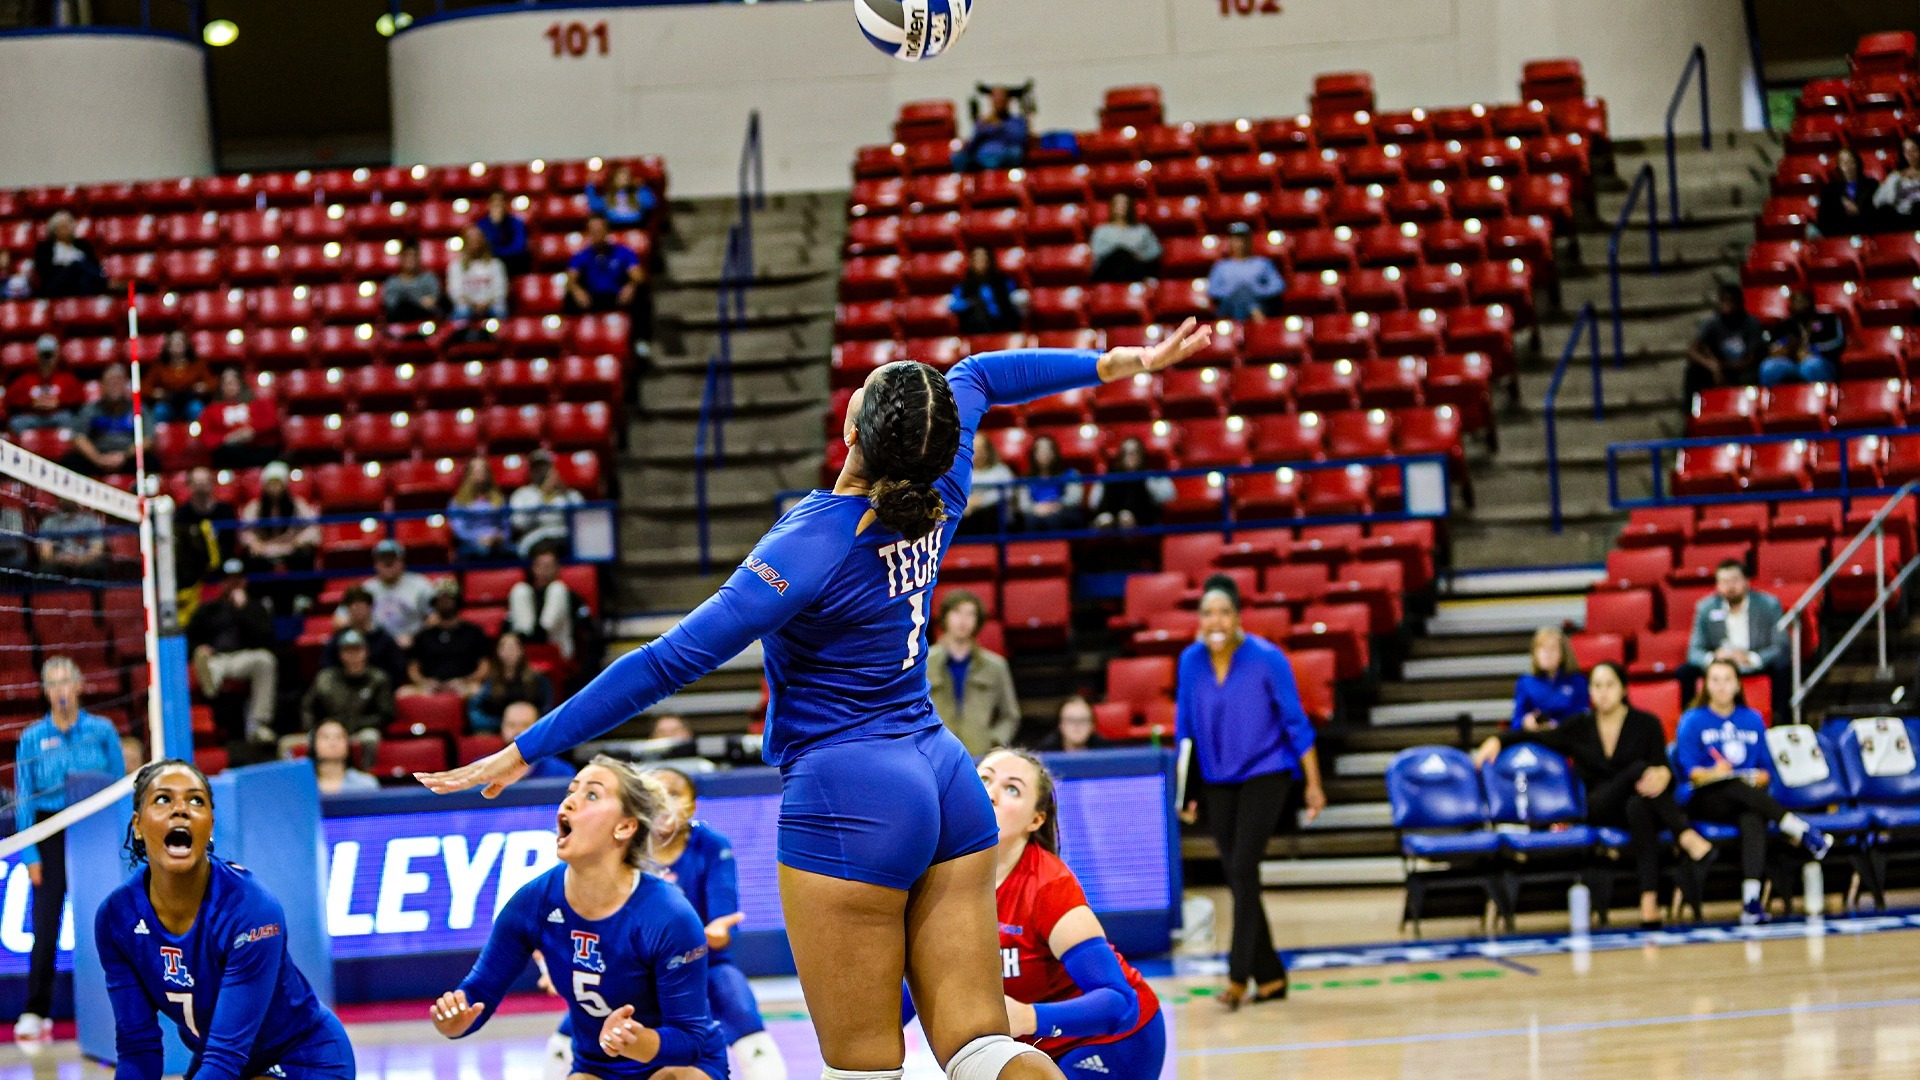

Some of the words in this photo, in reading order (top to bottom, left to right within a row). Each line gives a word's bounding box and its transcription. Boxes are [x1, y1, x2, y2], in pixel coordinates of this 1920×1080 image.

[545, 21, 609, 58] 101
[906, 9, 925, 57] molten
[926, 11, 947, 55] NCAA
[750, 557, 790, 596] USA
[878, 527, 944, 598] TECH
[901, 590, 927, 671] 1
[249, 923, 281, 943] USA
[165, 992, 200, 1038] 7
[572, 970, 613, 1018] 5
